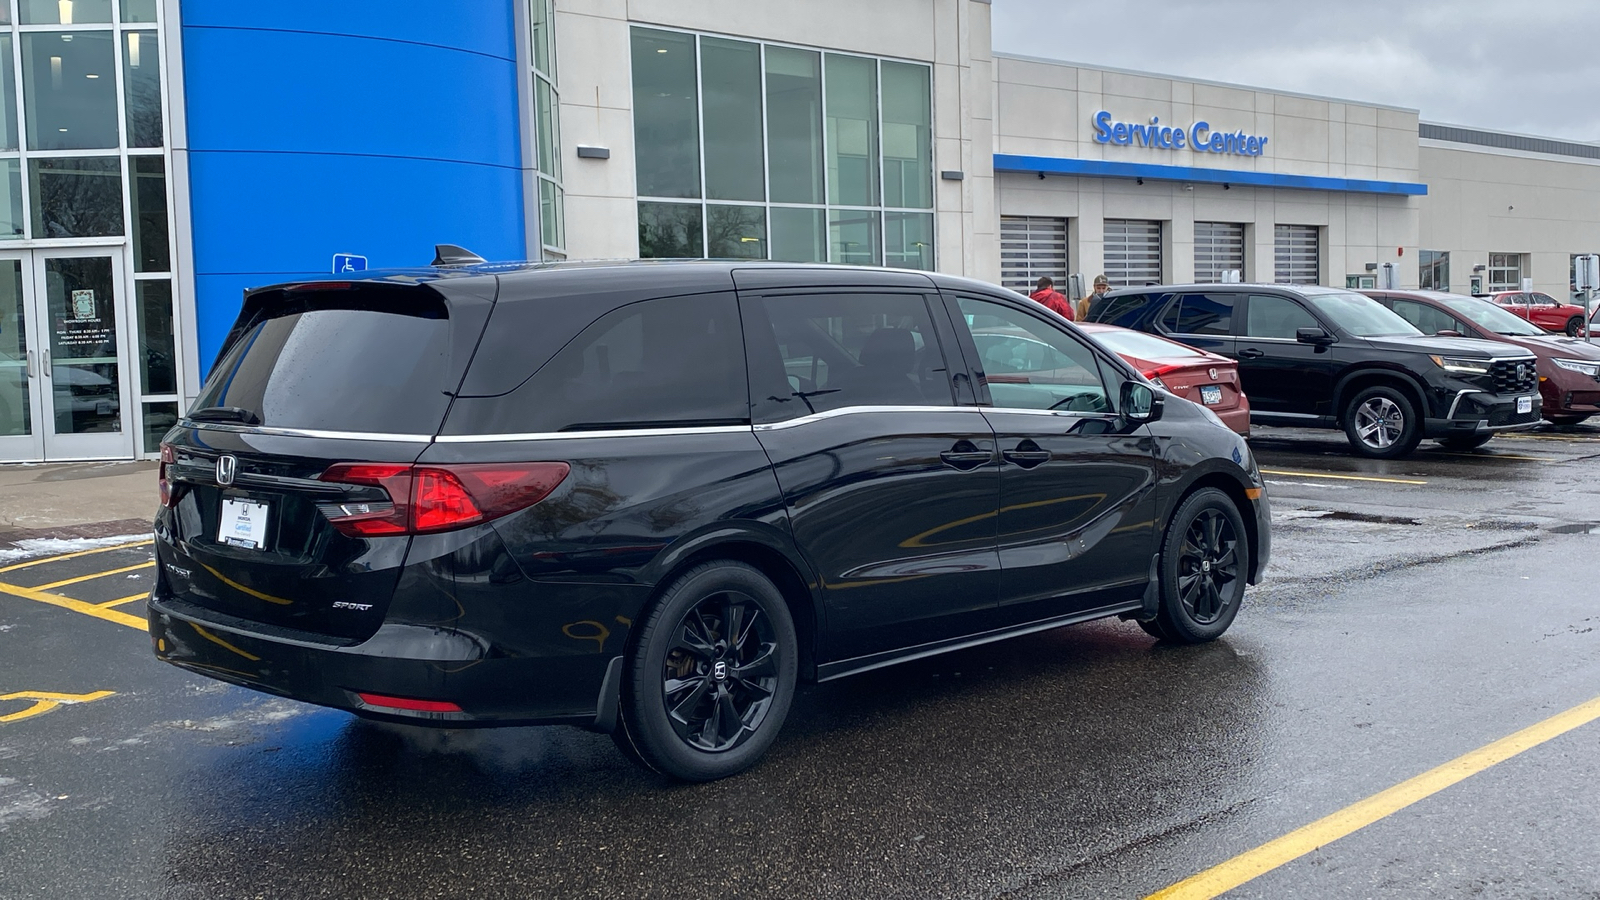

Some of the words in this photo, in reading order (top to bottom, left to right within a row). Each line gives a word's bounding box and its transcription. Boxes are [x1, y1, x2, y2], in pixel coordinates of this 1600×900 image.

[1092, 110, 1186, 150] Service
[1188, 120, 1268, 156] Center
[235, 524, 252, 532] Certified
[332, 601, 373, 611] SPORT
